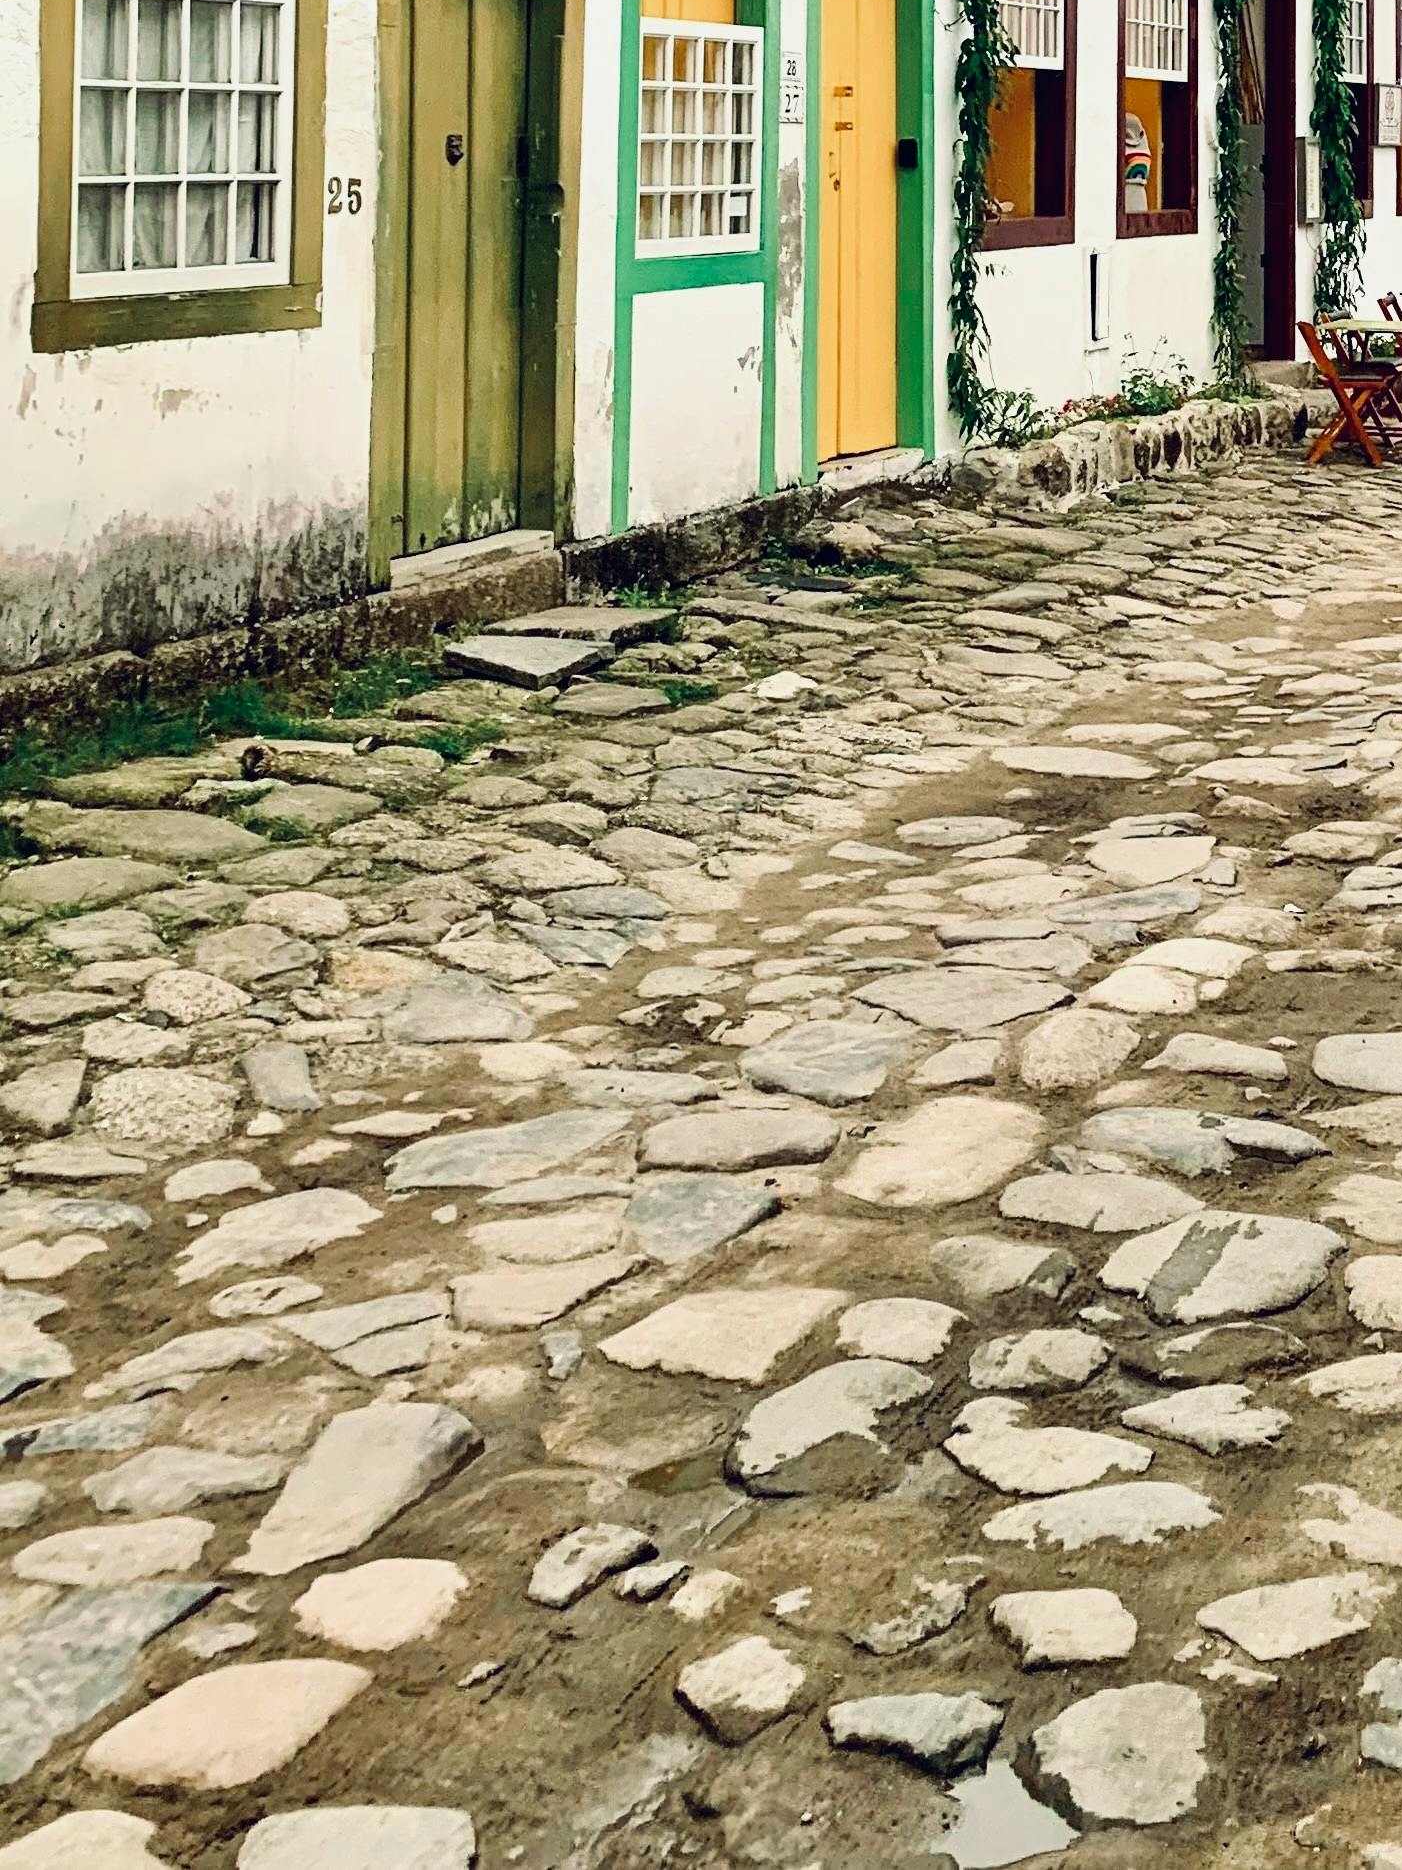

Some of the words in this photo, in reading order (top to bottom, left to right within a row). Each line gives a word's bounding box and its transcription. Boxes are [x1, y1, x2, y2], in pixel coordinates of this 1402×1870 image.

[786, 59, 797, 76] 28
[785, 93, 800, 113] 27
[328, 176, 362, 215] 25
